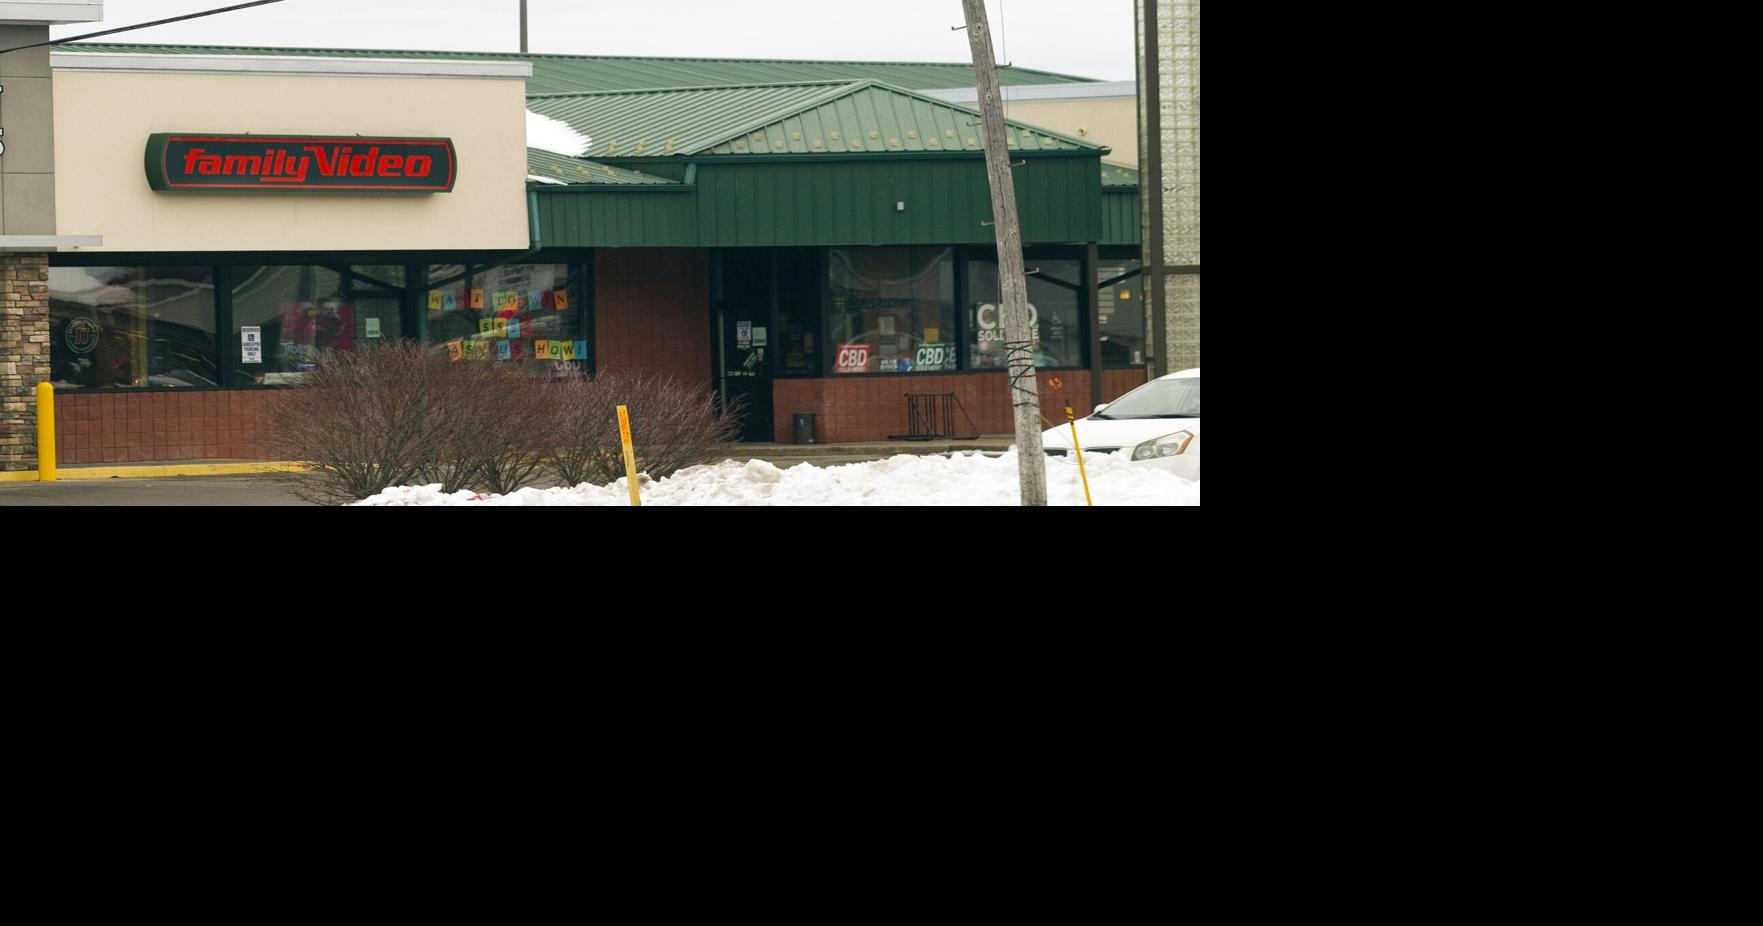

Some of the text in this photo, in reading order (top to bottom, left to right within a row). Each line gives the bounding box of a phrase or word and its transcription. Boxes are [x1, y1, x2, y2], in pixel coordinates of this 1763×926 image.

[537, 343, 581, 354] HOW!
[917, 348, 944, 365] CBD
[839, 349, 867, 367] CBD
